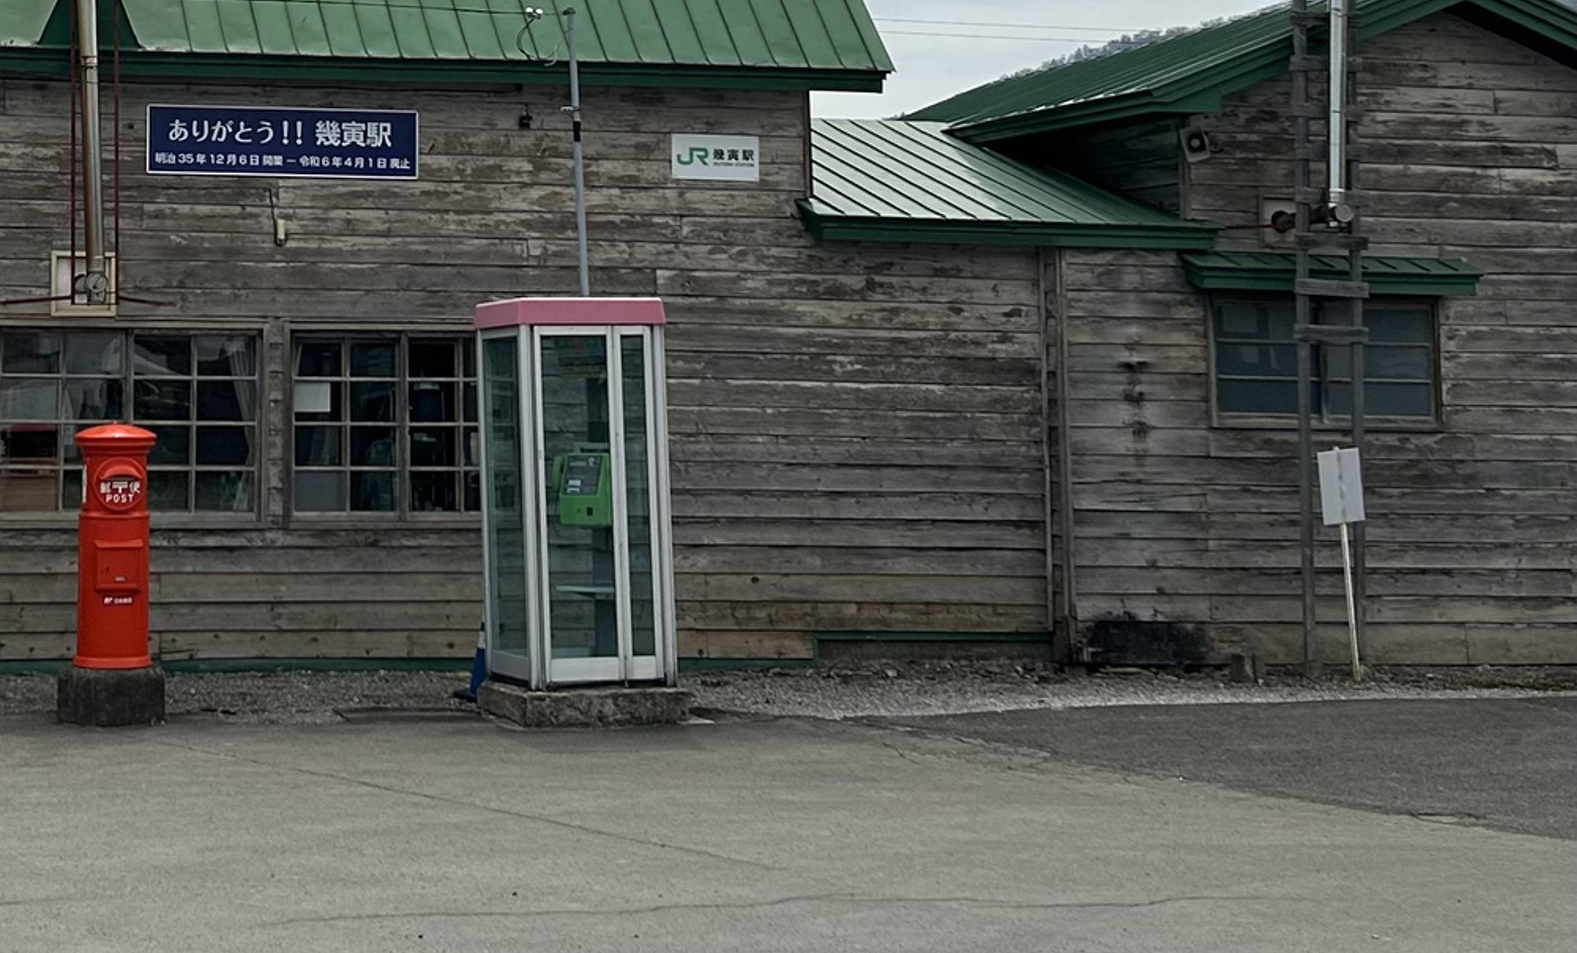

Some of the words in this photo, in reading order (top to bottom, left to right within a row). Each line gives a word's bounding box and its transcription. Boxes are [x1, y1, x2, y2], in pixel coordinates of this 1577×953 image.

[315, 120, 392, 148] 幾寅駅
[676, 147, 709, 166] JR
[105, 494, 134, 504] POST
